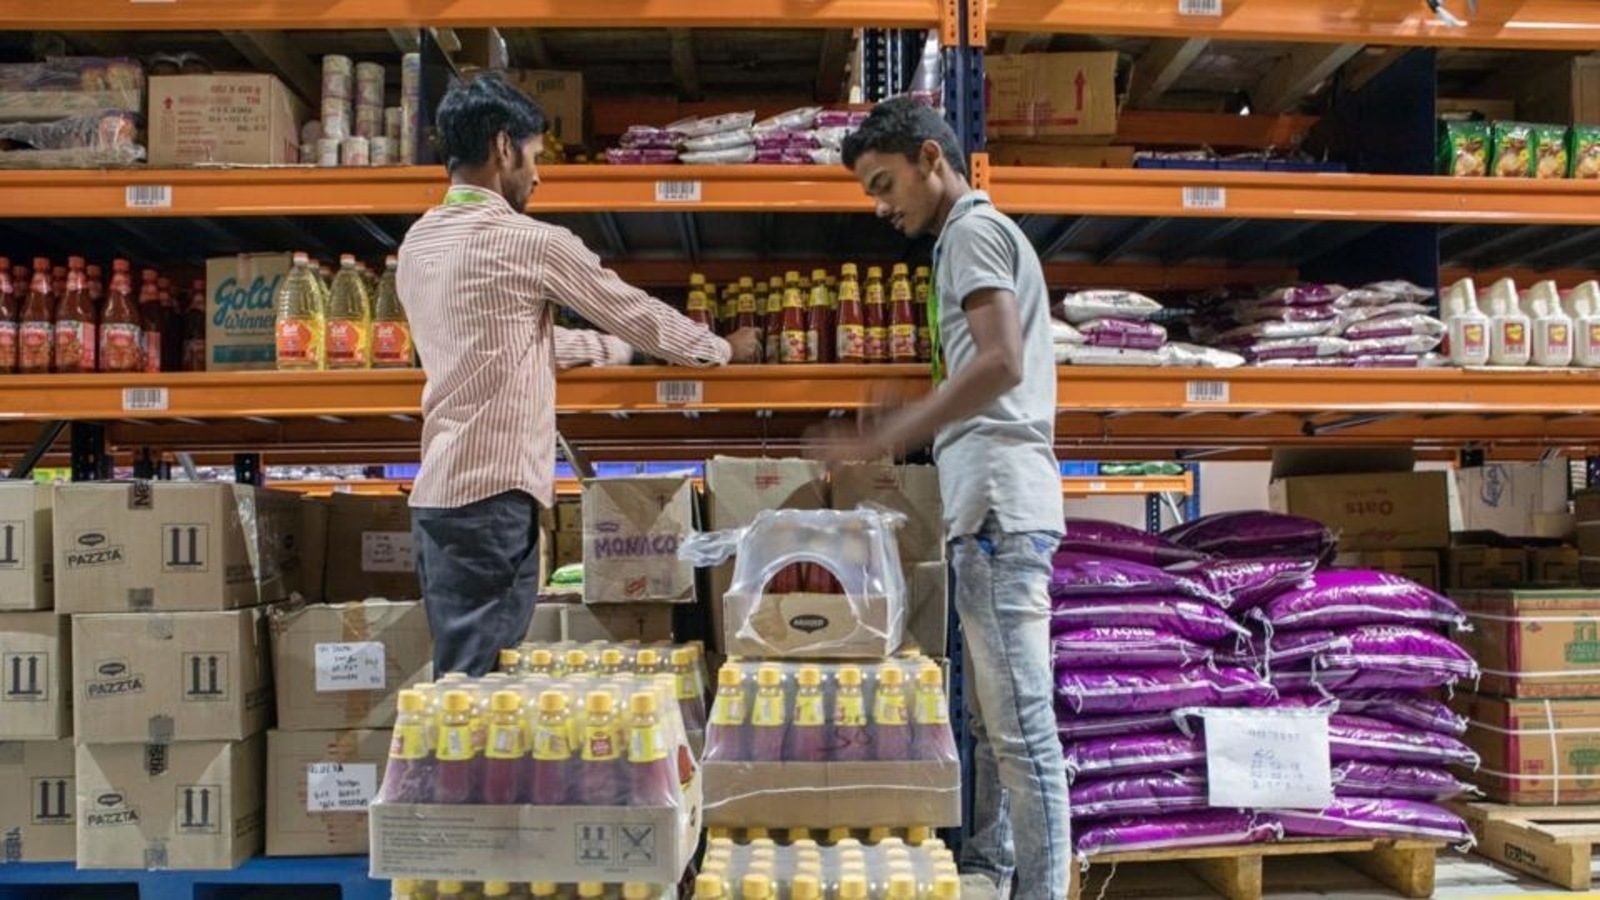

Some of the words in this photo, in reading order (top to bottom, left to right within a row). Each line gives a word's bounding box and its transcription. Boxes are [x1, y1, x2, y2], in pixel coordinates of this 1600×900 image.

[214, 275, 281, 325] Gold
[1346, 500, 1394, 516] Oats
[595, 534, 679, 559] MONACO
[67, 549, 123, 566] PAZZTA
[88, 679, 142, 696] PAZZTA
[87, 809, 139, 826] PAZZTA
